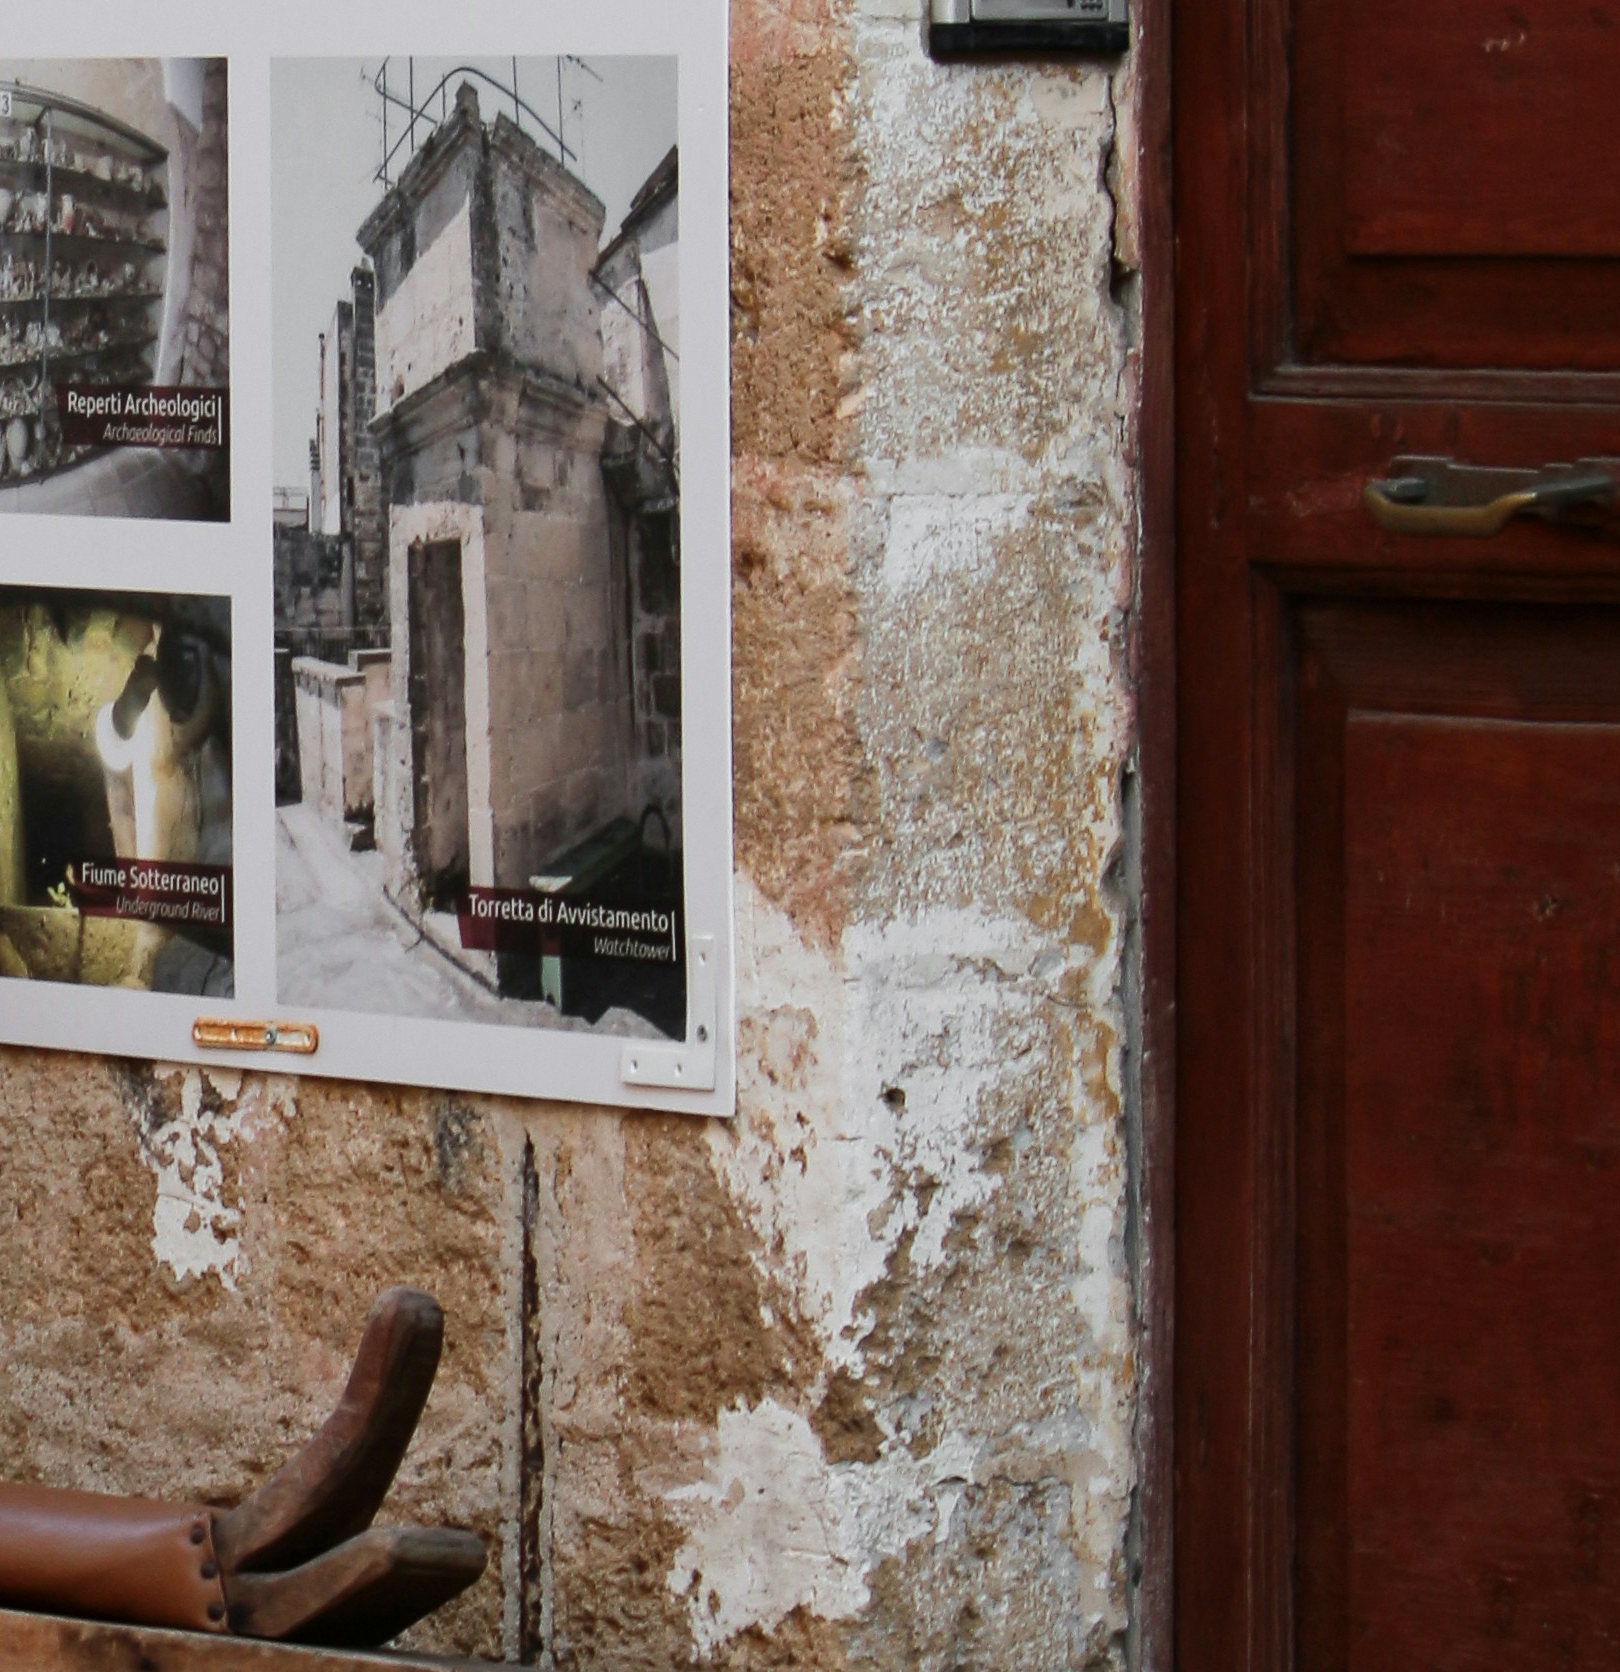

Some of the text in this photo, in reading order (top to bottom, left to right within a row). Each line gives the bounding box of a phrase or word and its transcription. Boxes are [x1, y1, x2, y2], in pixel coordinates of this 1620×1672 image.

[68, 391, 216, 422] Reperti Archeologici
[103, 423, 217, 446] Archaeological Finds
[82, 862, 219, 895] Fiume Sotterraneo
[116, 895, 220, 921] Underground River
[468, 893, 668, 932] Torretta di Avvistamento
[594, 936, 671, 960] Watchtower
